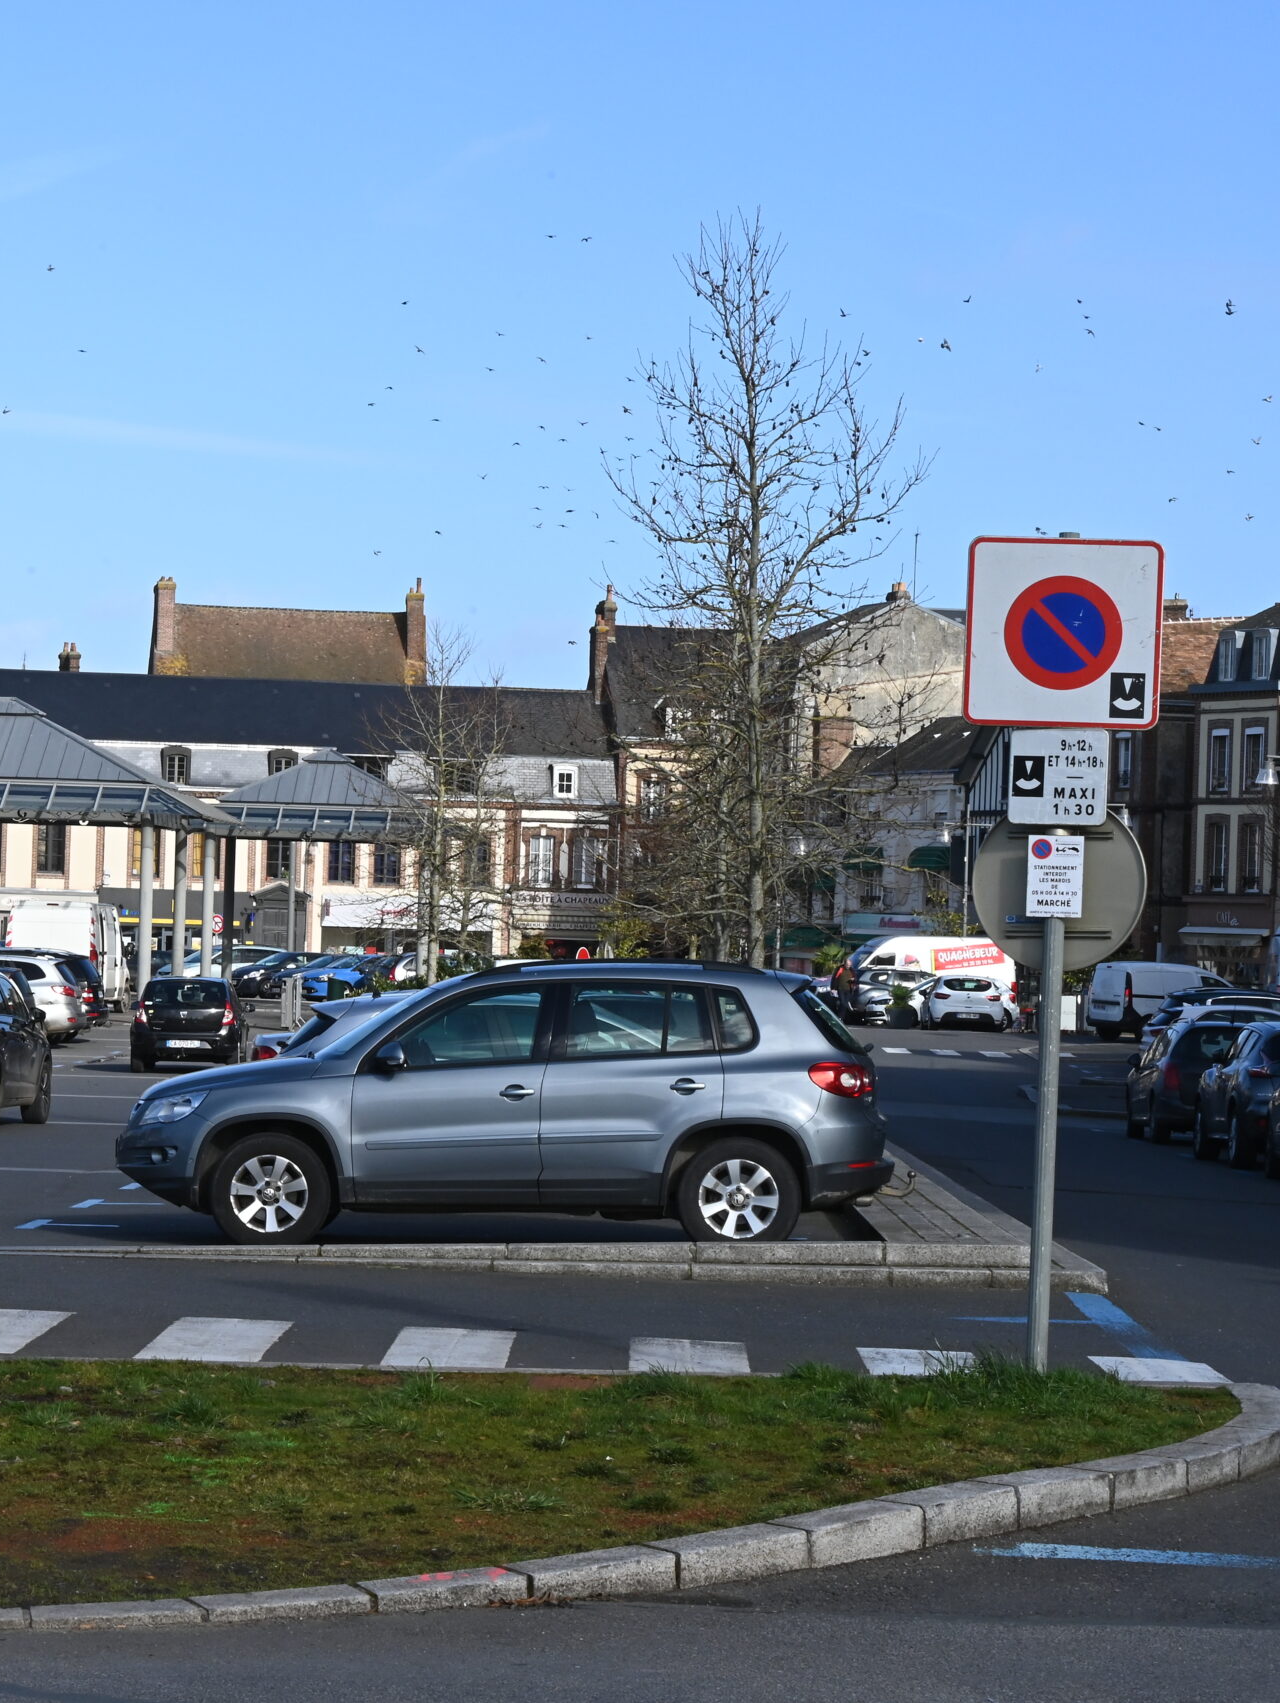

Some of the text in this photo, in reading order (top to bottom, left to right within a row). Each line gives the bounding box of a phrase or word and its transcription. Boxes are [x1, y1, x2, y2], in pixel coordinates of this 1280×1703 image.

[1047, 755, 1061, 768] ET
[1053, 787, 1096, 801] MAXI
[564, 895, 611, 905] CHAPEAUX
[1037, 897, 1072, 908] MARCHÉ
